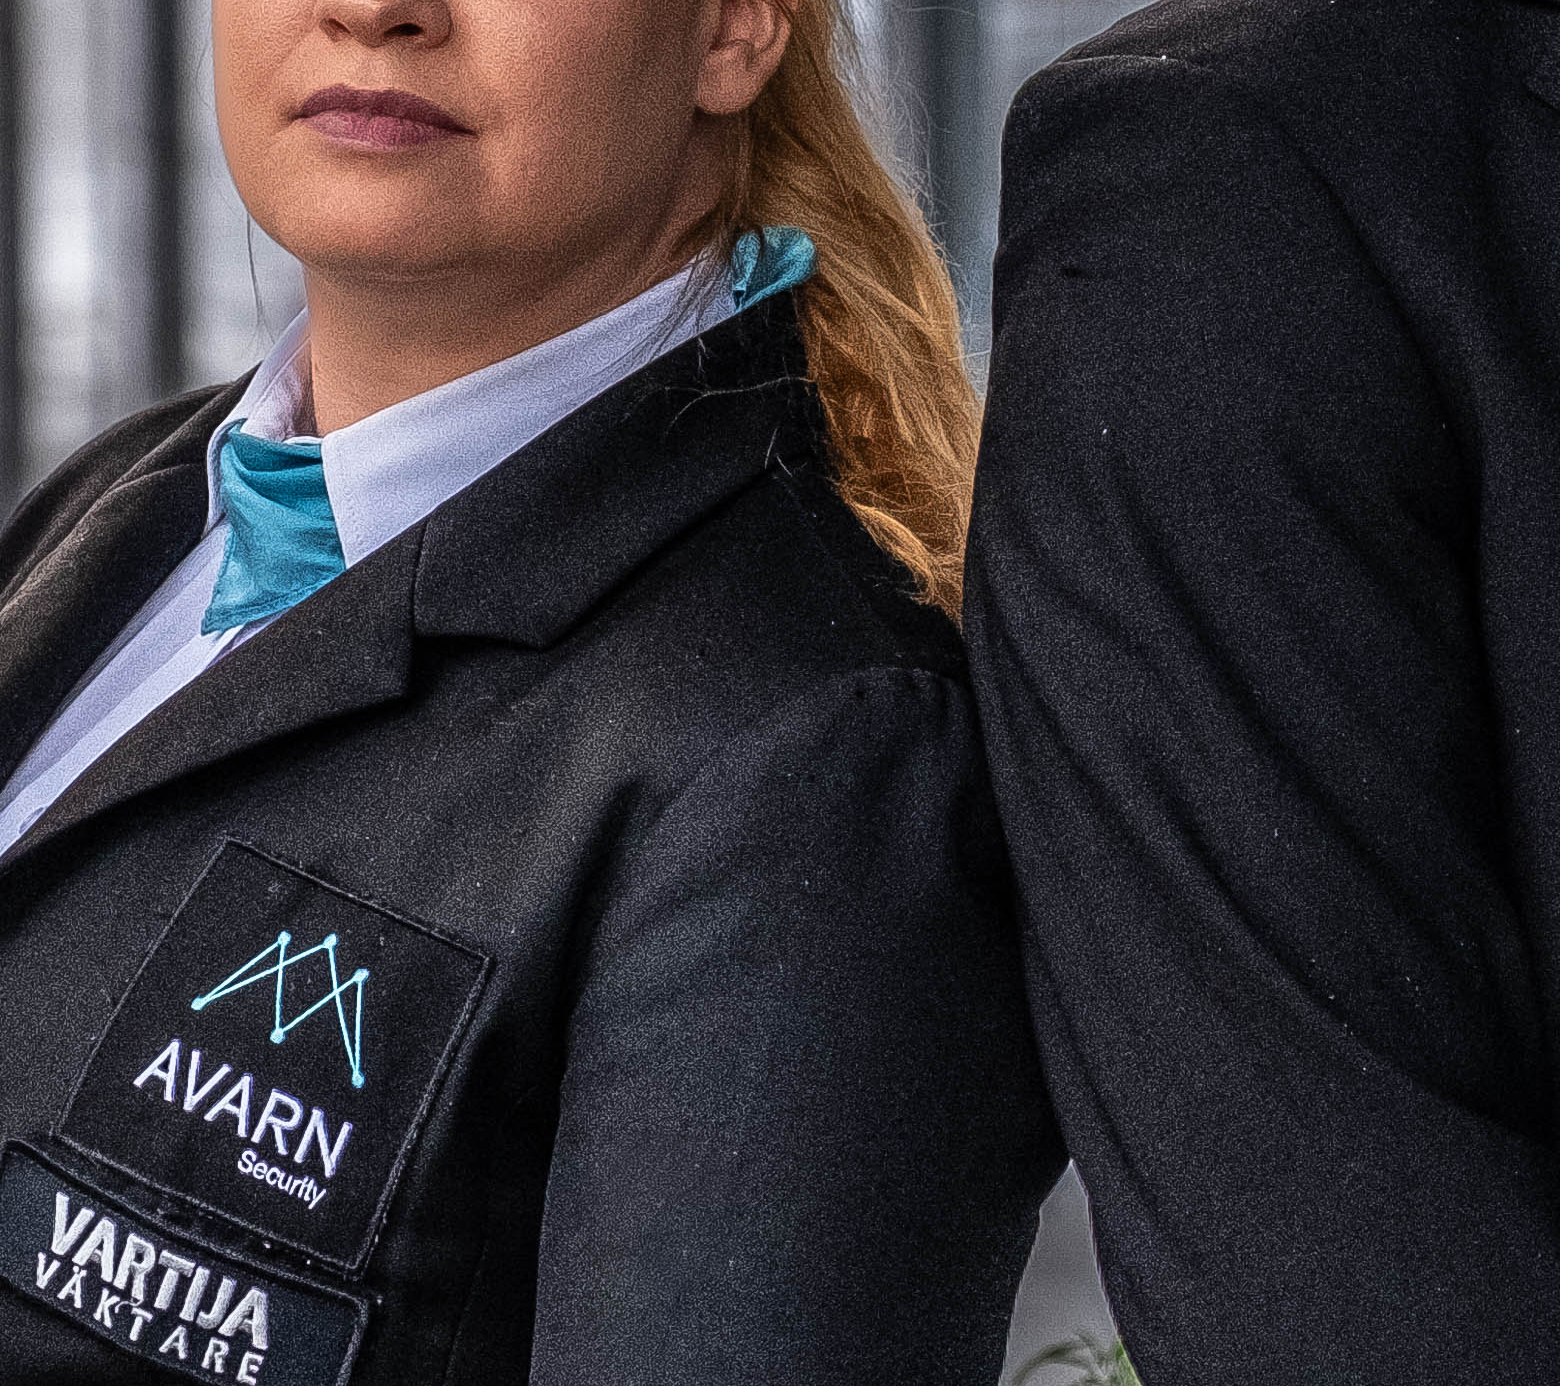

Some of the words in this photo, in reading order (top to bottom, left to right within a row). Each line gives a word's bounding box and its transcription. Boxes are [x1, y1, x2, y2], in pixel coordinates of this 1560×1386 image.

[133, 1038, 354, 1179] AVARN
[237, 1149, 328, 1210] Security
[35, 1251, 265, 1386] VÄKTARE
[49, 1190, 269, 1350] VARTIJA
